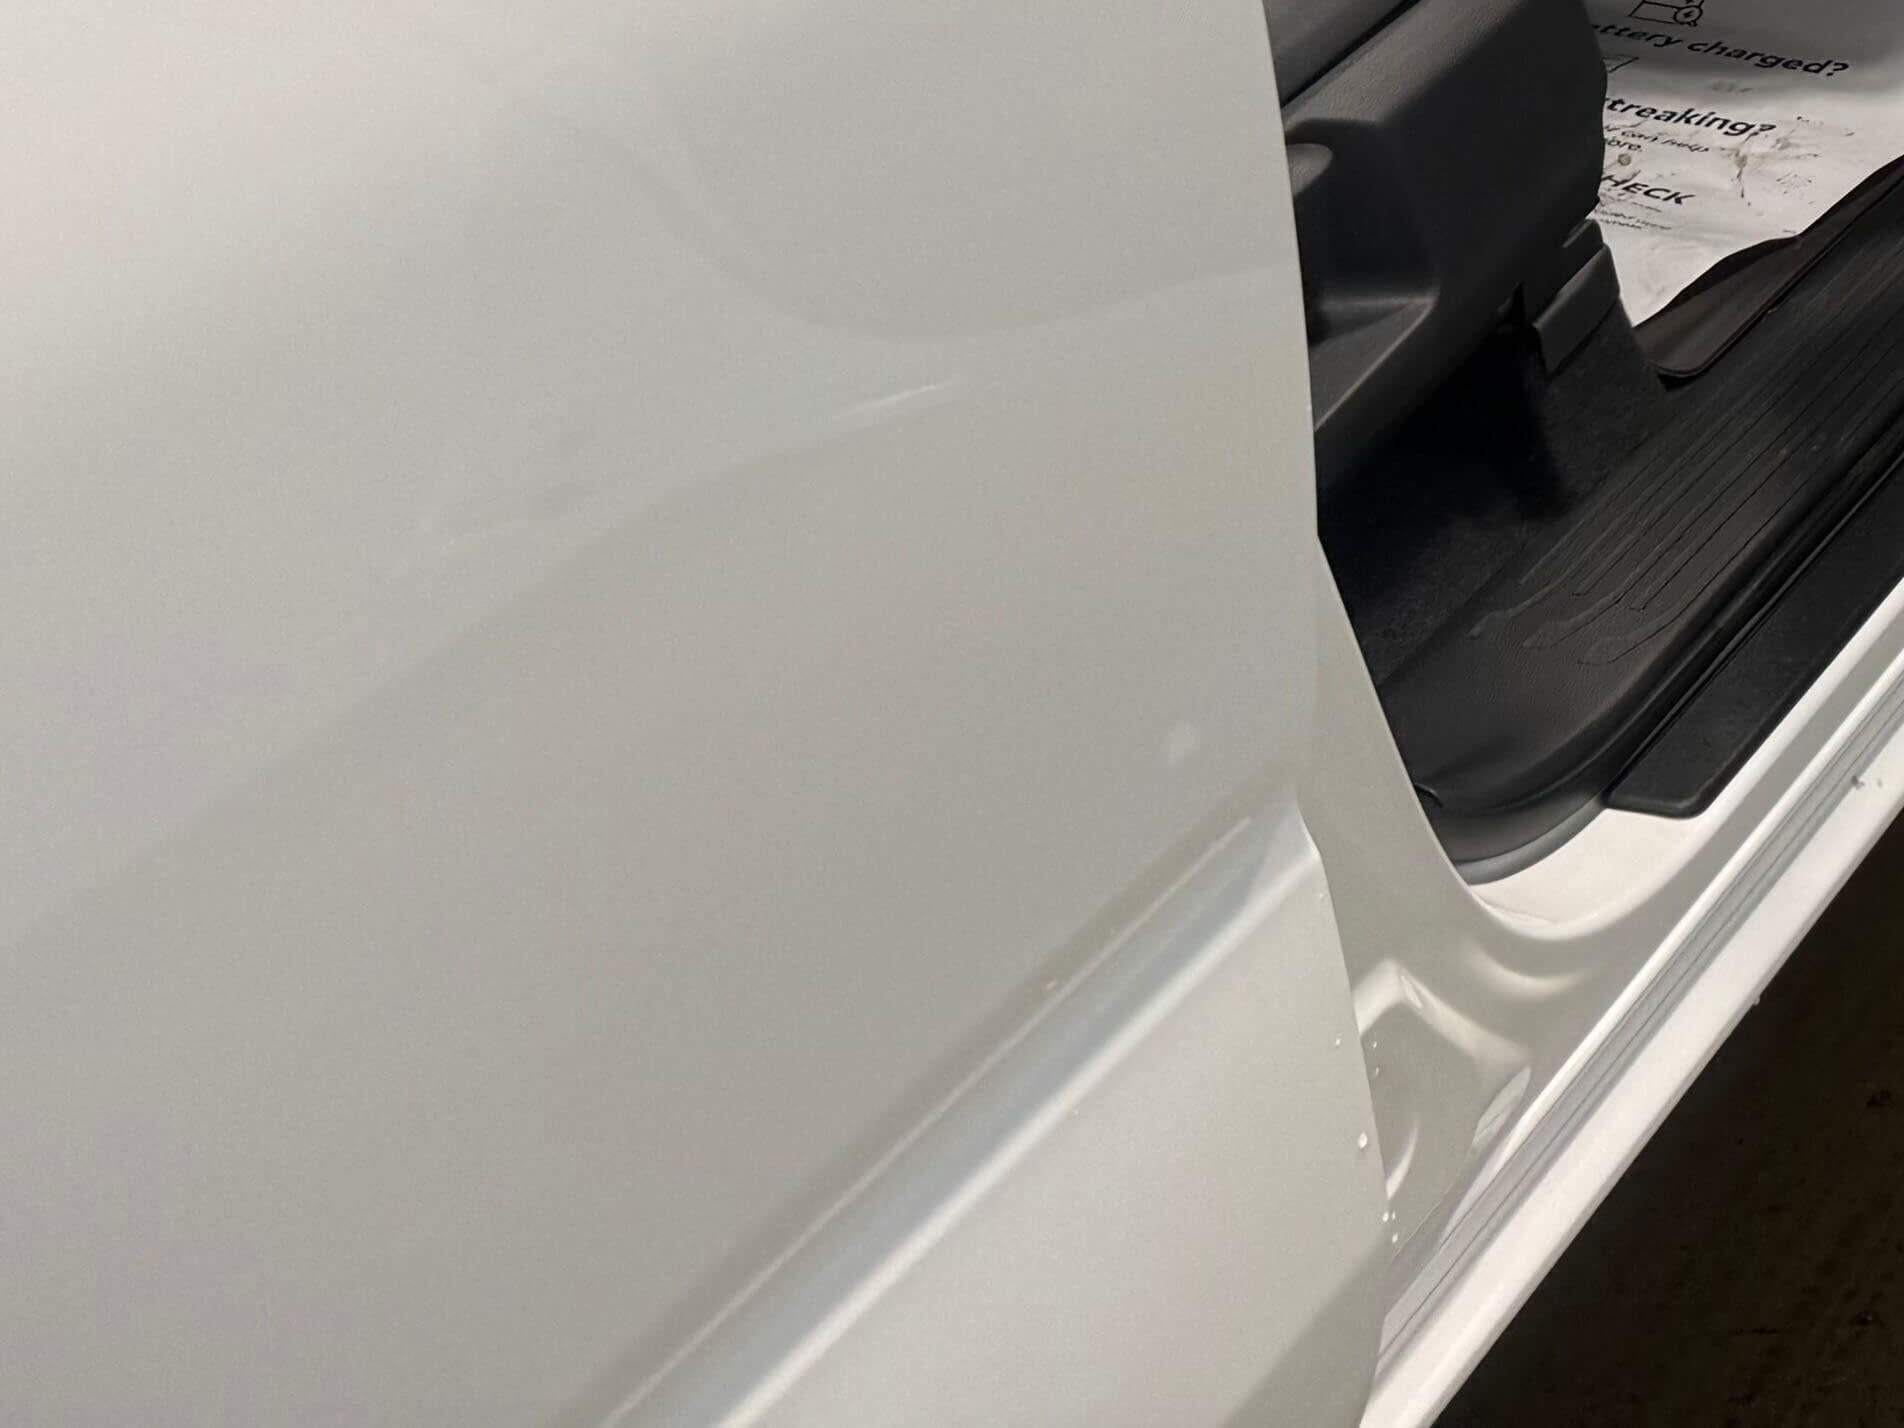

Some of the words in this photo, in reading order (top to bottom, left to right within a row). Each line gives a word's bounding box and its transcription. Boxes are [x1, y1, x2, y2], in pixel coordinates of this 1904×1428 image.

[1593, 24, 1684, 48] ttery
[1687, 40, 1849, 76] charged?
[1604, 97, 1777, 137] treaking?
[1604, 138, 1643, 153] ore.
[1601, 170, 1696, 205] HECK
